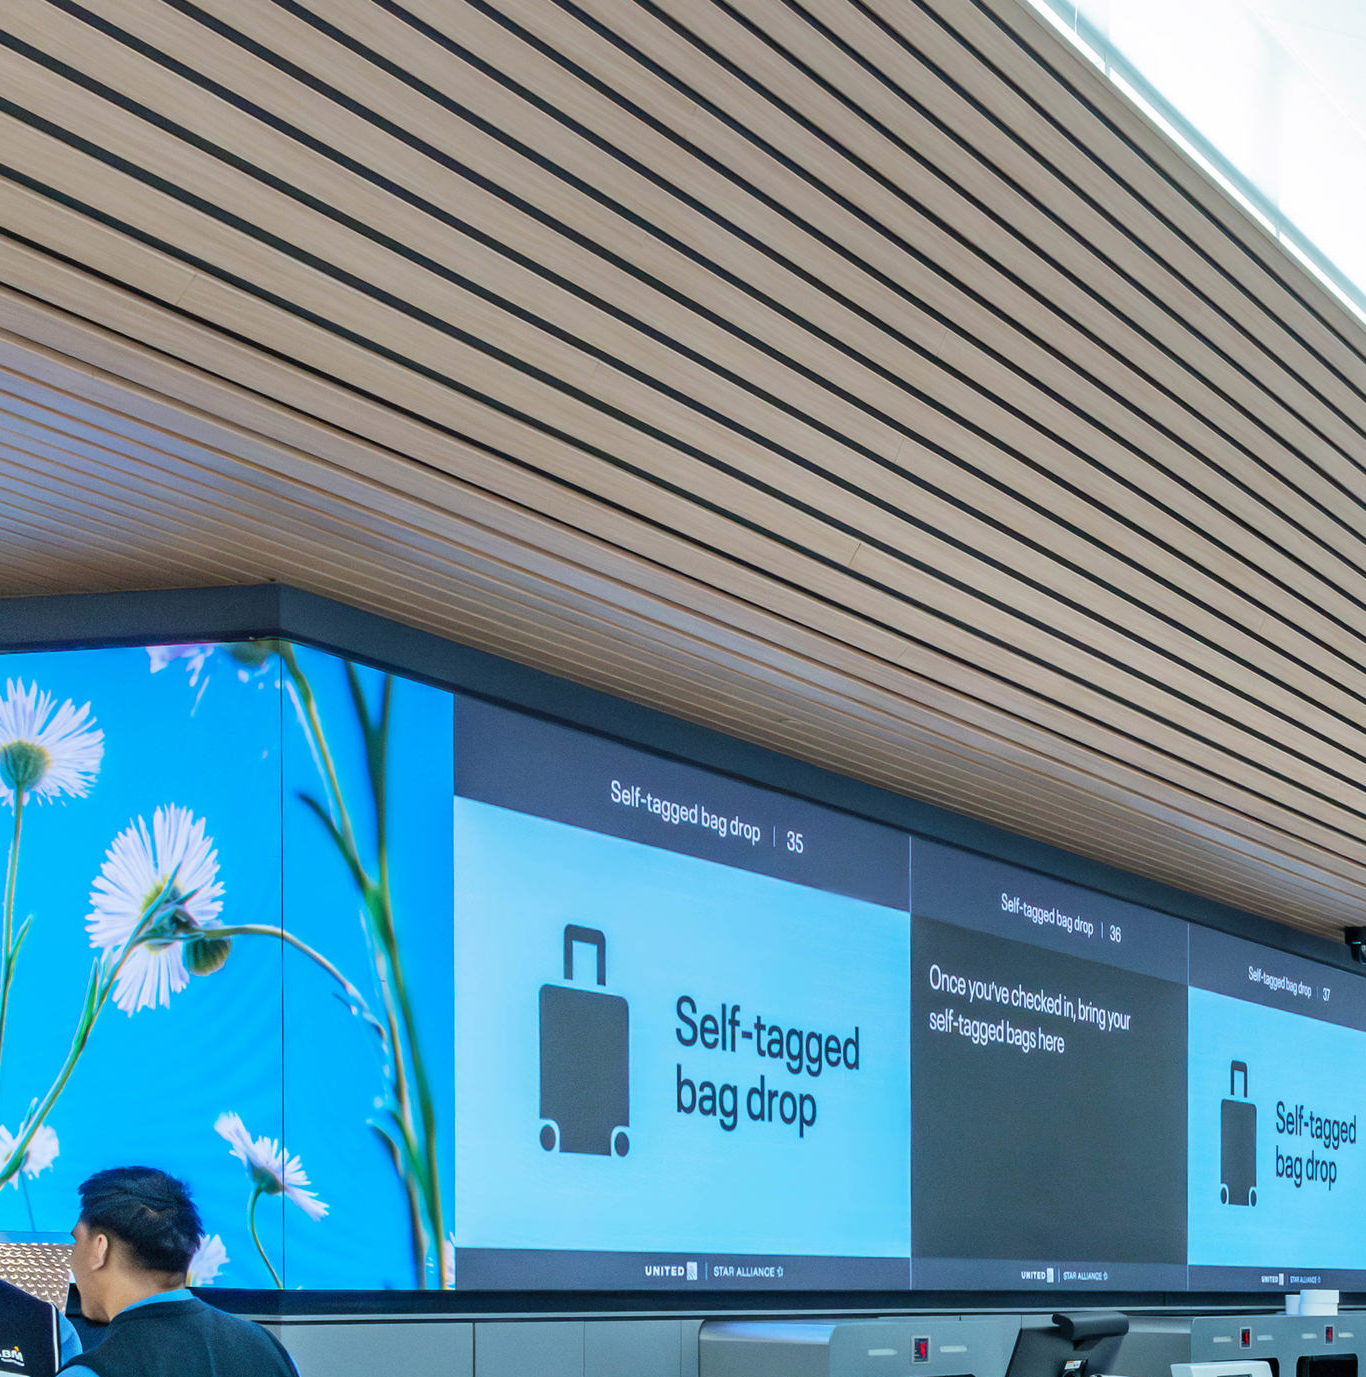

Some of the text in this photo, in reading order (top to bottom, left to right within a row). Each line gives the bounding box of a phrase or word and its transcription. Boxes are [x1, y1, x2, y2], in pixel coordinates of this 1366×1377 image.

[610, 779, 804, 853] Self-tagged bag drop 35
[1001, 892, 1122, 943] Self-tagged bag drop 36
[929, 964, 1131, 1032] Once you've checked in, bring your
[1248, 966, 1285, 991] Self-tagged
[1286, 977, 1298, 996] bag
[1298, 981, 1312, 999] drop
[675, 995, 860, 1078] Self-tagged
[929, 1008, 1065, 1054] self-tagged bags here
[676, 1063, 817, 1138] bag drop
[1275, 1101, 1357, 1150] Self-tagged
[1276, 1145, 1337, 1191] bag drop
[645, 1265, 775, 1278] UNITED STAR ALLIANCE
[1021, 1271, 1046, 1280] UNITED
